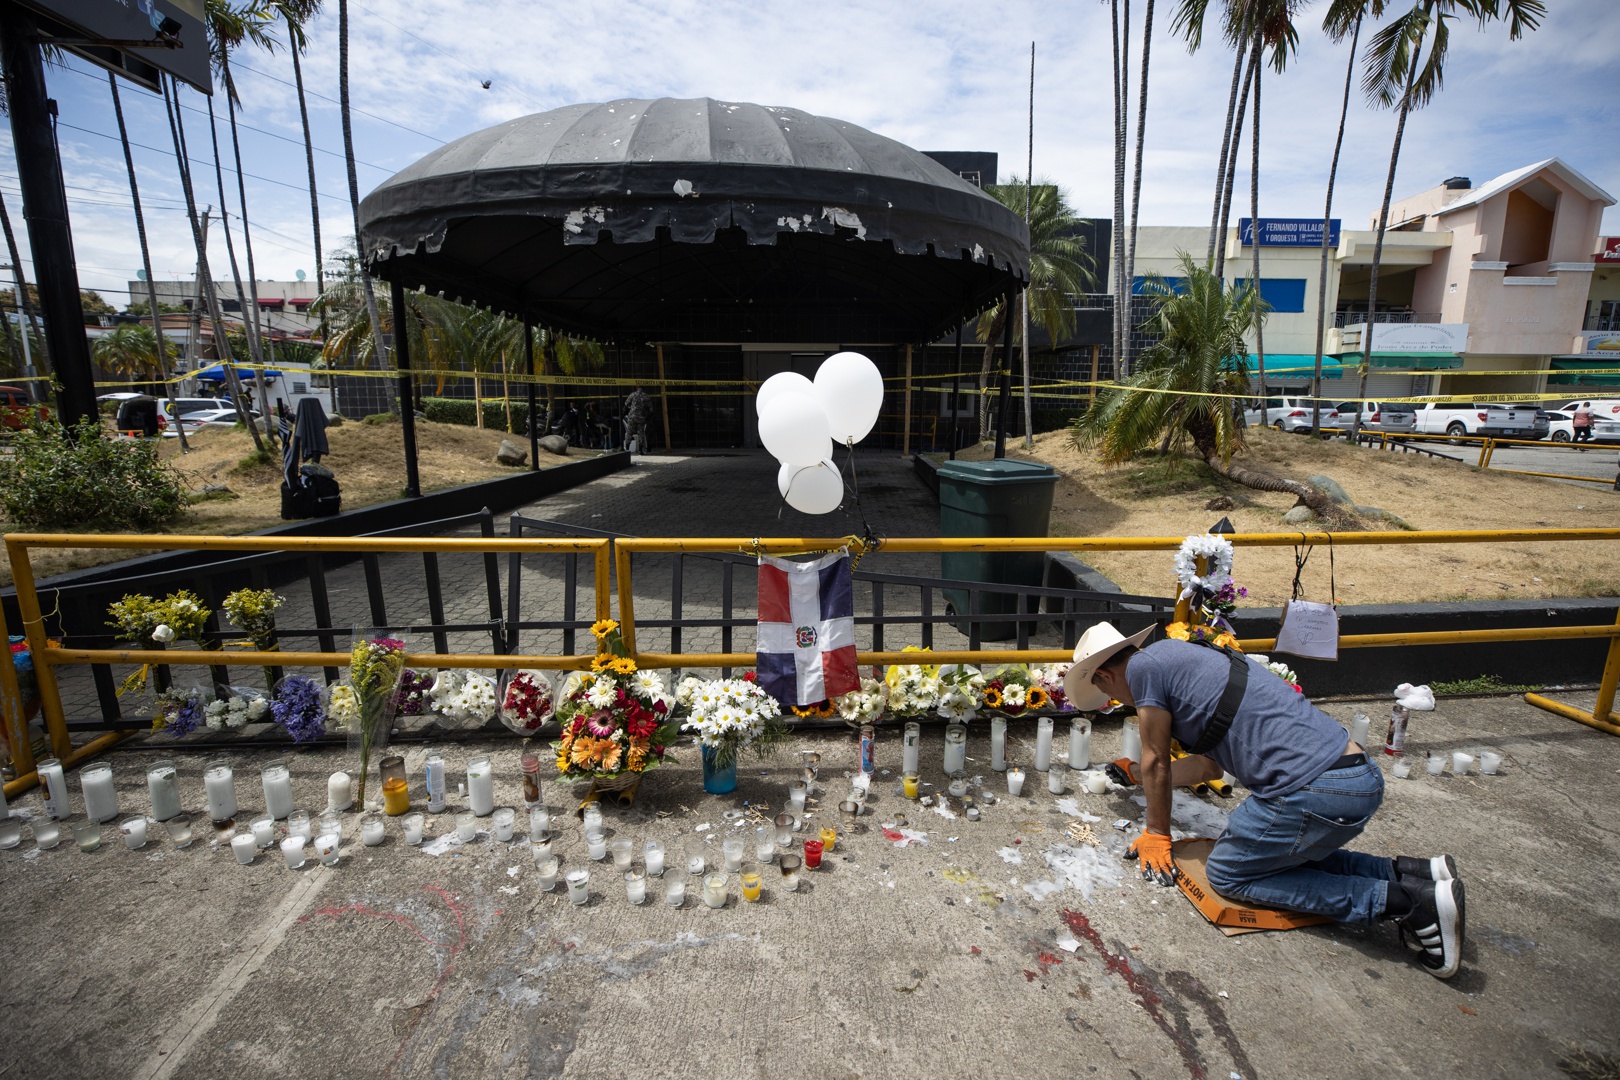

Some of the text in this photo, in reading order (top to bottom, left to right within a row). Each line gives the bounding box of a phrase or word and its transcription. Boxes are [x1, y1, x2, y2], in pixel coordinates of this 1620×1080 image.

[1266, 222, 1298, 232] FERNANDO
[1265, 234, 1269, 242] Y
[1270, 233, 1297, 243] ORQUESTA
[554, 376, 575, 384] SECURITY
[1239, 916, 1257, 924] MASA
